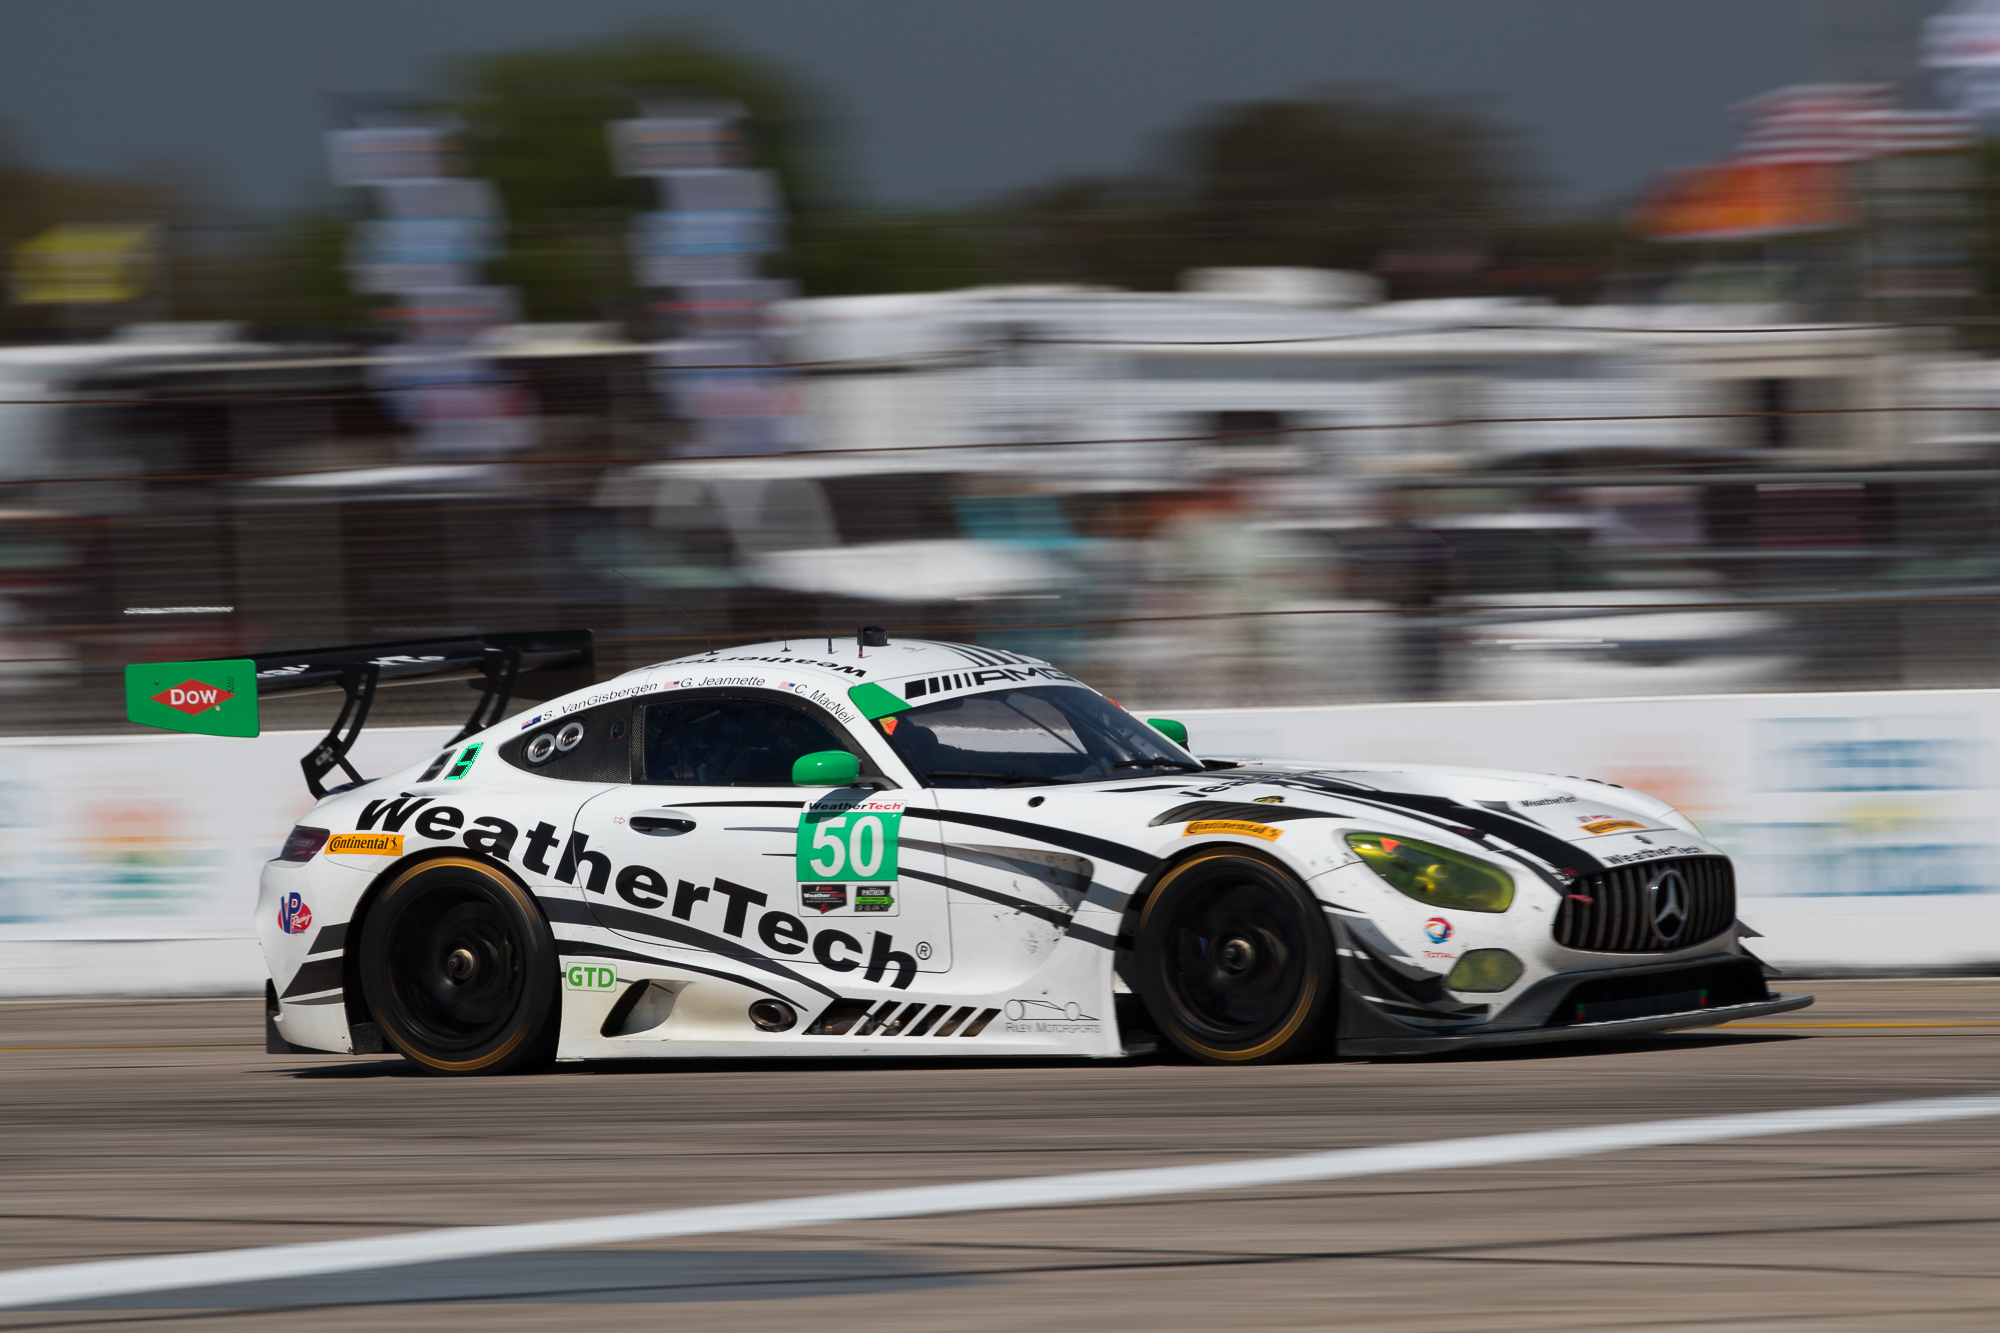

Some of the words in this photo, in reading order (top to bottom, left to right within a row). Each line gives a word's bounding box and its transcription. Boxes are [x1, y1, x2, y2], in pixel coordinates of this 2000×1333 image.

[698, 676, 766, 688] Jeannette
[562, 682, 658, 715] VanGisbergen
[809, 689, 856, 726] MacNeil
[808, 802, 902, 811] WeatherTech
[329, 836, 390, 852] Continental
[810, 815, 884, 878] 50
[280, 892, 302, 934] VP
[568, 966, 615, 989] GTD
